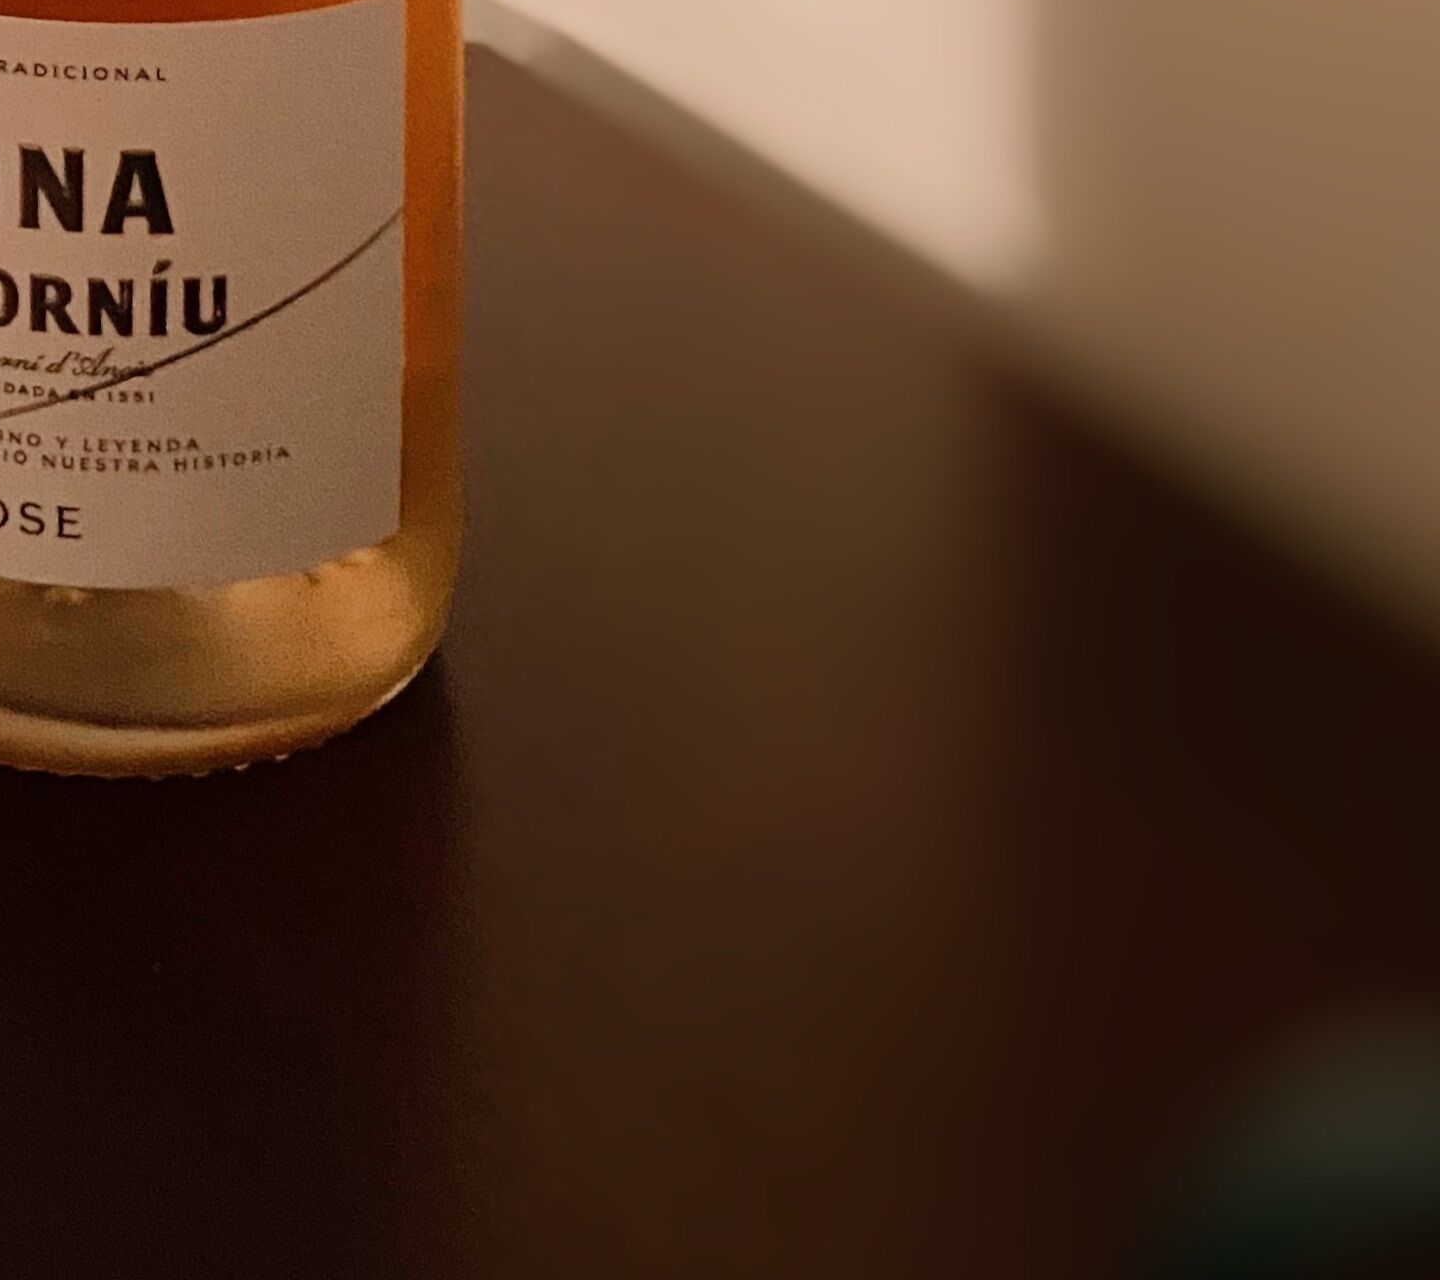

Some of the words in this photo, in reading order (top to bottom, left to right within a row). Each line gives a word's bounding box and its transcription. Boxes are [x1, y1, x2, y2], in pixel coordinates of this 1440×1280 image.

[55, 435, 68, 450] Y
[82, 437, 201, 454] LEYENDA
[40, 453, 160, 474] NUESTRA
